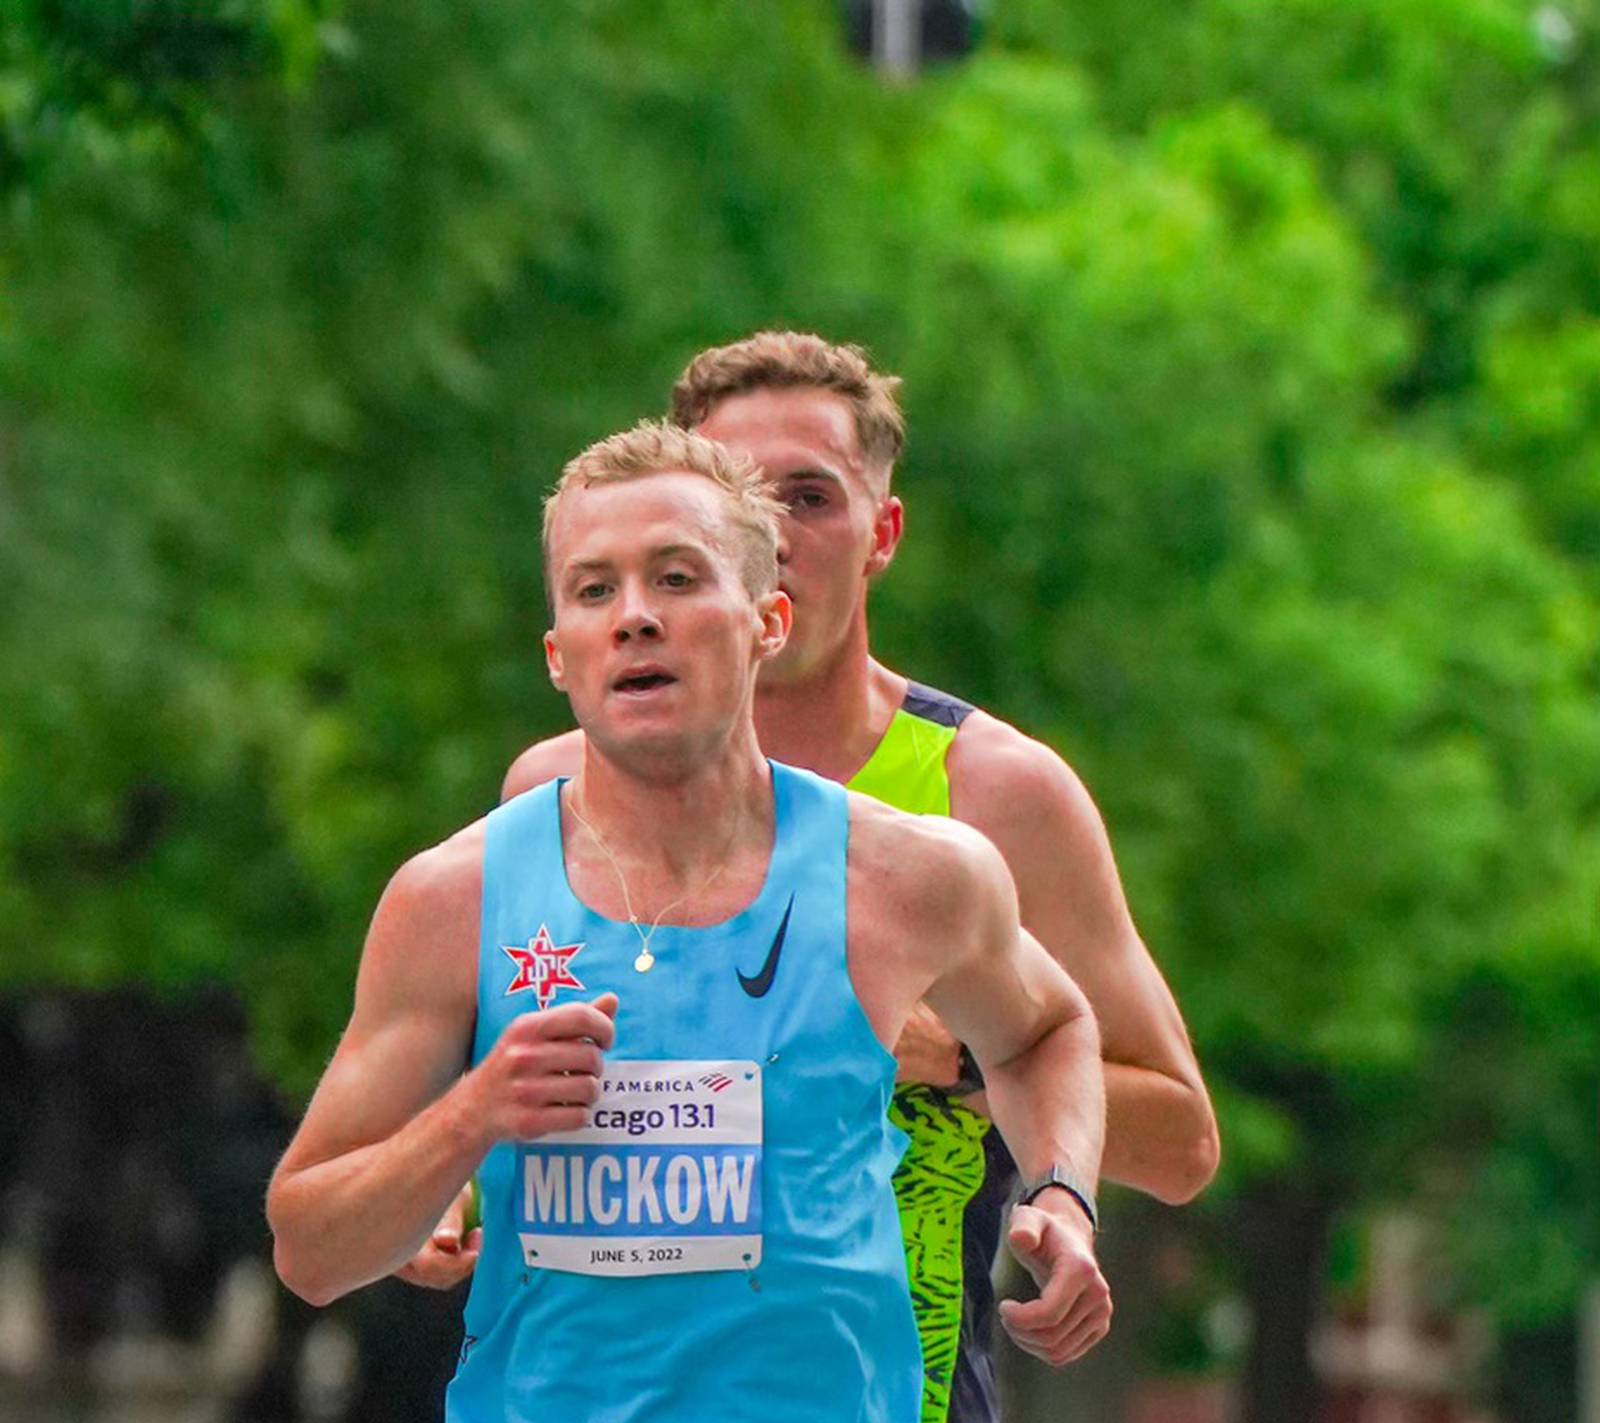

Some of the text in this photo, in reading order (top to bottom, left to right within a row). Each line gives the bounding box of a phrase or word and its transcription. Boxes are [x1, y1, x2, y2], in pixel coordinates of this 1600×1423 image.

[602, 1080, 695, 1093] F AMERICA
[587, 1103, 715, 1136] cago 13.1
[523, 1154, 755, 1226] MICKOW
[589, 1247, 683, 1264] JUNE 5, 2022
